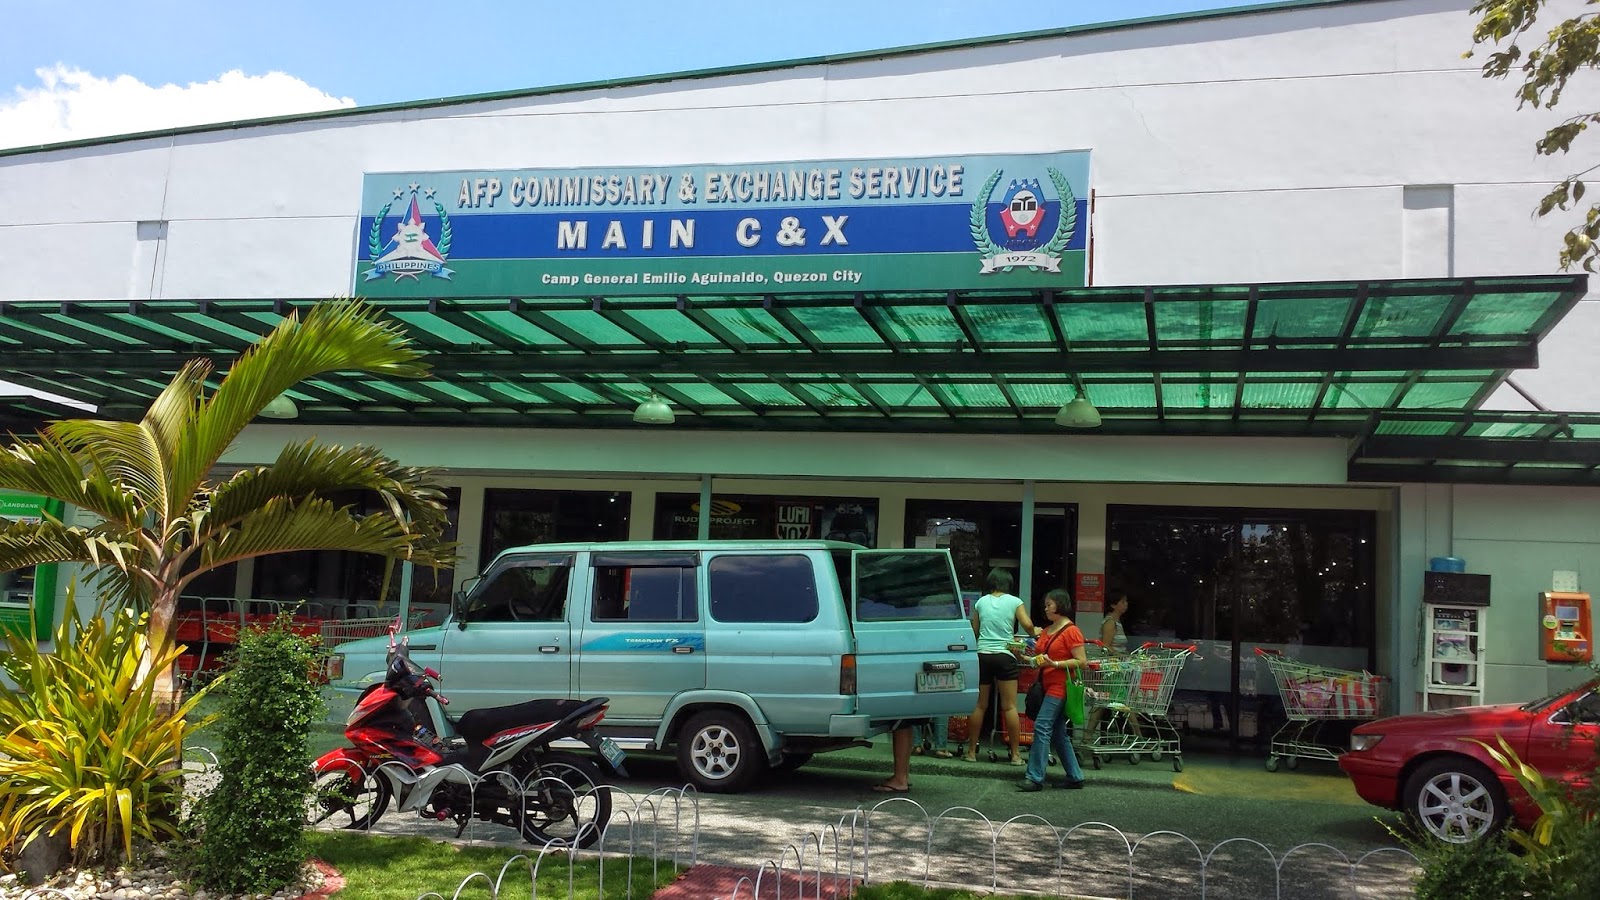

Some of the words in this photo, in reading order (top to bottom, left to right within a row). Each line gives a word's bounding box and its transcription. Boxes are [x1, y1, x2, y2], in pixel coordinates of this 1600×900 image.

[458, 177, 503, 208] AFP
[510, 173, 672, 207] COMMISSARY
[679, 171, 698, 204] &
[704, 167, 842, 203] EXCHANGE
[849, 164, 964, 200] SERVICE
[557, 219, 696, 250] MAIN
[377, 261, 440, 271] PHILIPPINES
[1005, 255, 1037, 263] 1972
[541, 273, 580, 286] Camp
[583, 272, 638, 285] General
[642, 272, 687, 285] Emilio
[691, 271, 769, 286] Aguinaldo,
[773, 270, 828, 284] Quezon
[832, 269, 863, 285] City
[674, 515, 701, 523] RUD
[709, 517, 757, 526] PROJECT
[778, 506, 810, 524] LUMI
